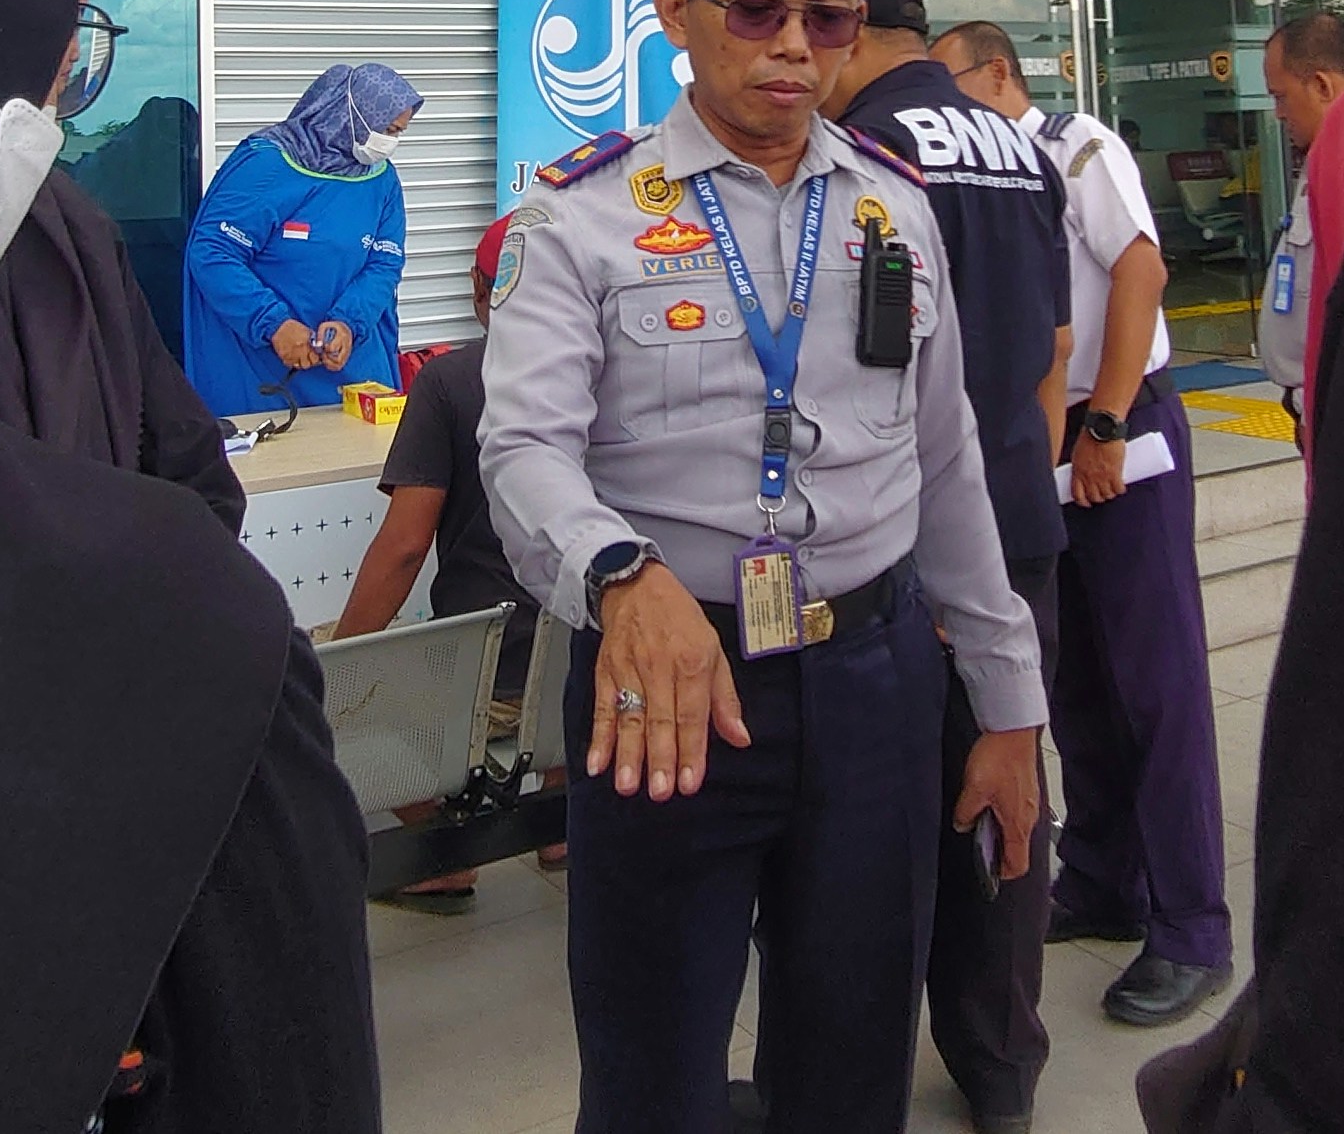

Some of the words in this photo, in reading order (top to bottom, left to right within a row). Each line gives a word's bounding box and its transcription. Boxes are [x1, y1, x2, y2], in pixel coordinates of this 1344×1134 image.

[892, 106, 1043, 175] BNN
[712, 215, 737, 257] KELAS
[803, 211, 819, 250] KELAS
[644, 254, 720, 274] VERIE
[729, 260, 752, 295] BPTD
[793, 262, 811, 300] JATIM
